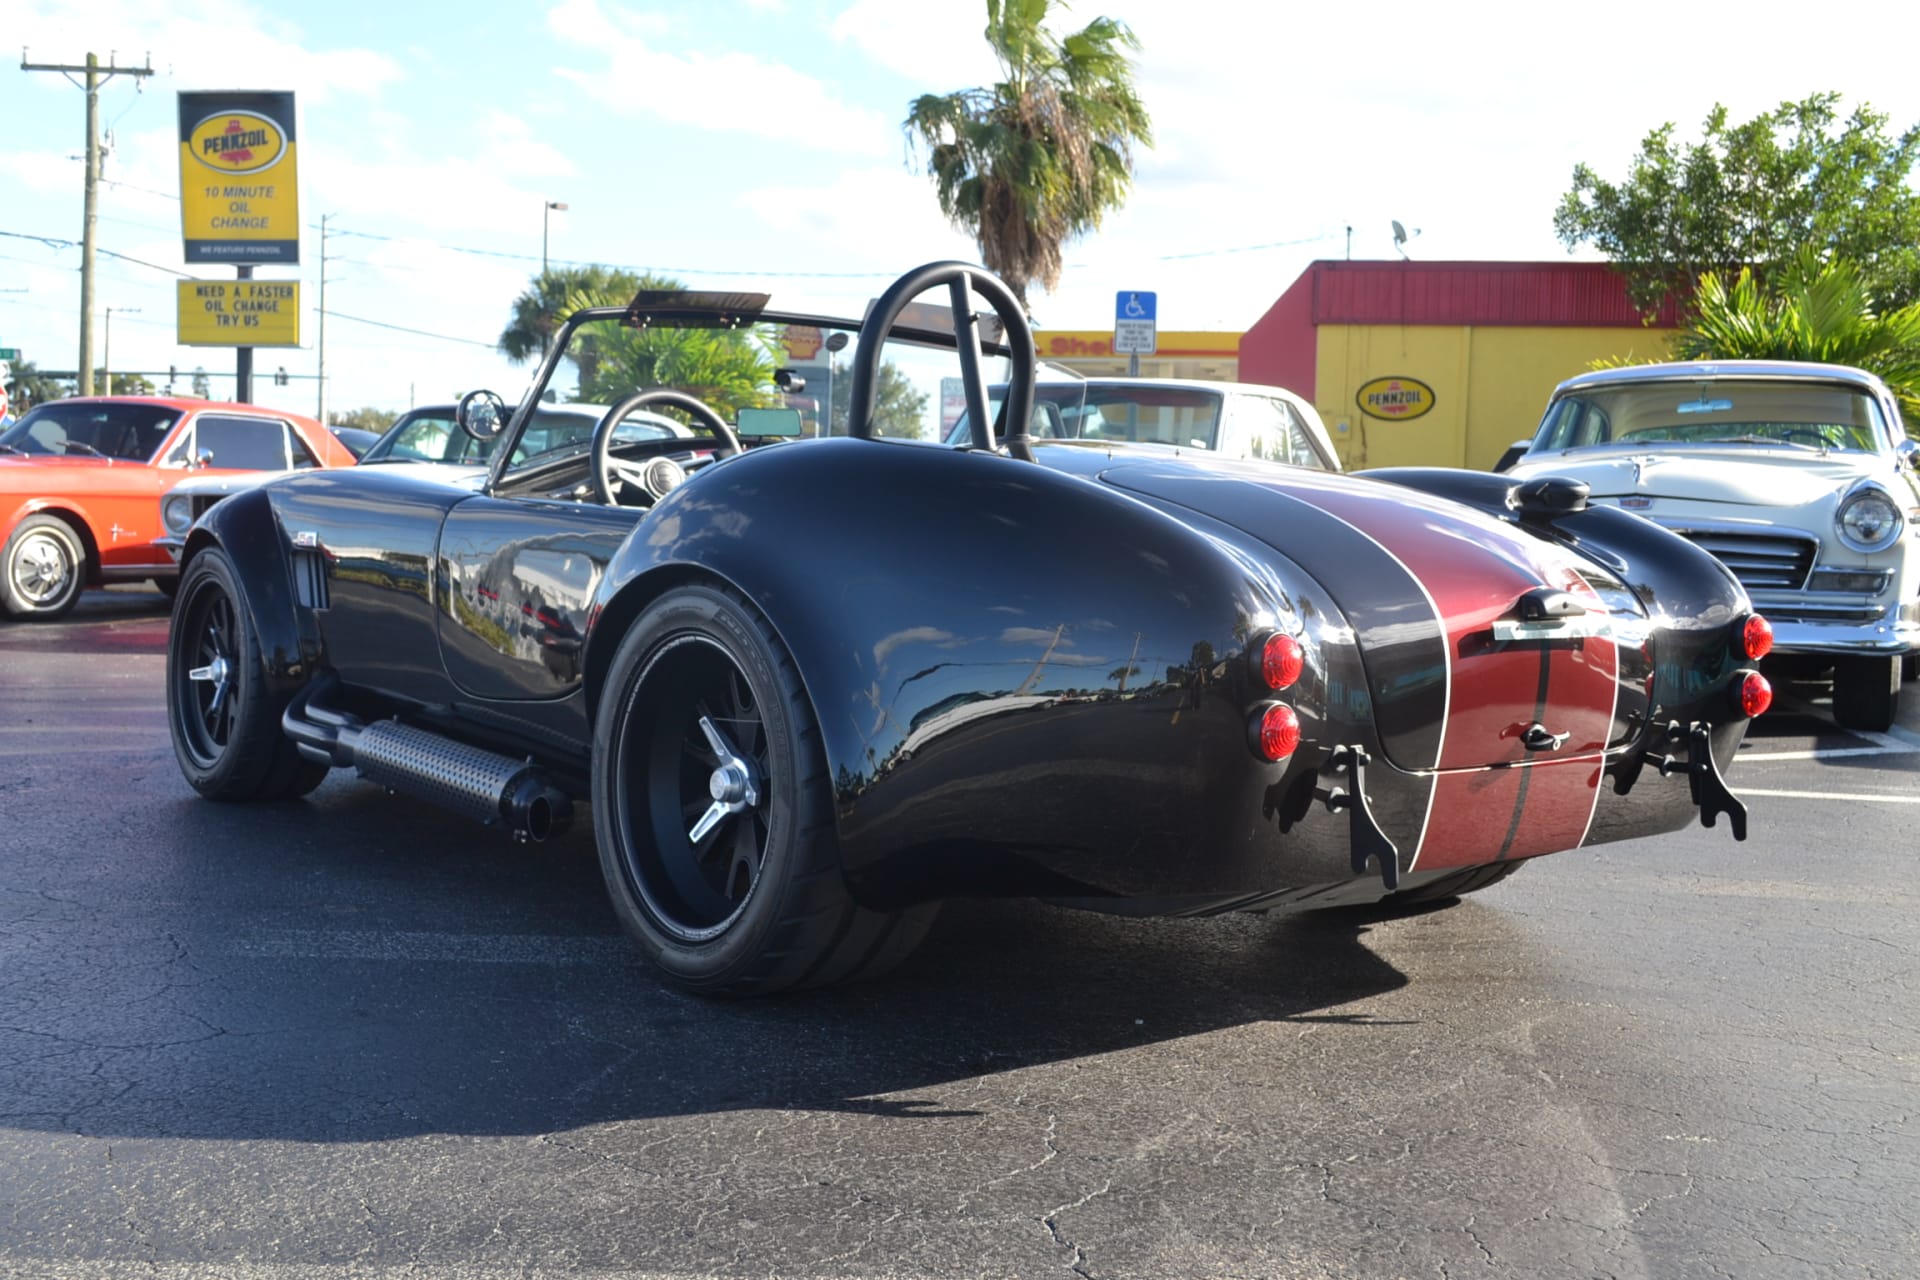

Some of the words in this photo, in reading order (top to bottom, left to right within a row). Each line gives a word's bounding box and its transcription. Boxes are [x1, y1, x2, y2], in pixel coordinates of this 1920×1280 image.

[204, 129, 268, 155] PENNZOIL
[205, 186, 220, 198] 10
[223, 186, 275, 198] MINUTE
[229, 201, 251, 214] OIL
[211, 217, 269, 229] CHANGE
[196, 286, 225, 297] NEED
[234, 286, 241, 297] A
[249, 286, 294, 299] FASTER
[205, 301, 224, 312] OIL
[233, 301, 279, 312] CHANGE
[216, 315, 239, 326] TRY
[243, 315, 259, 327] US
[1368, 390, 1421, 406] PENNZOIL
